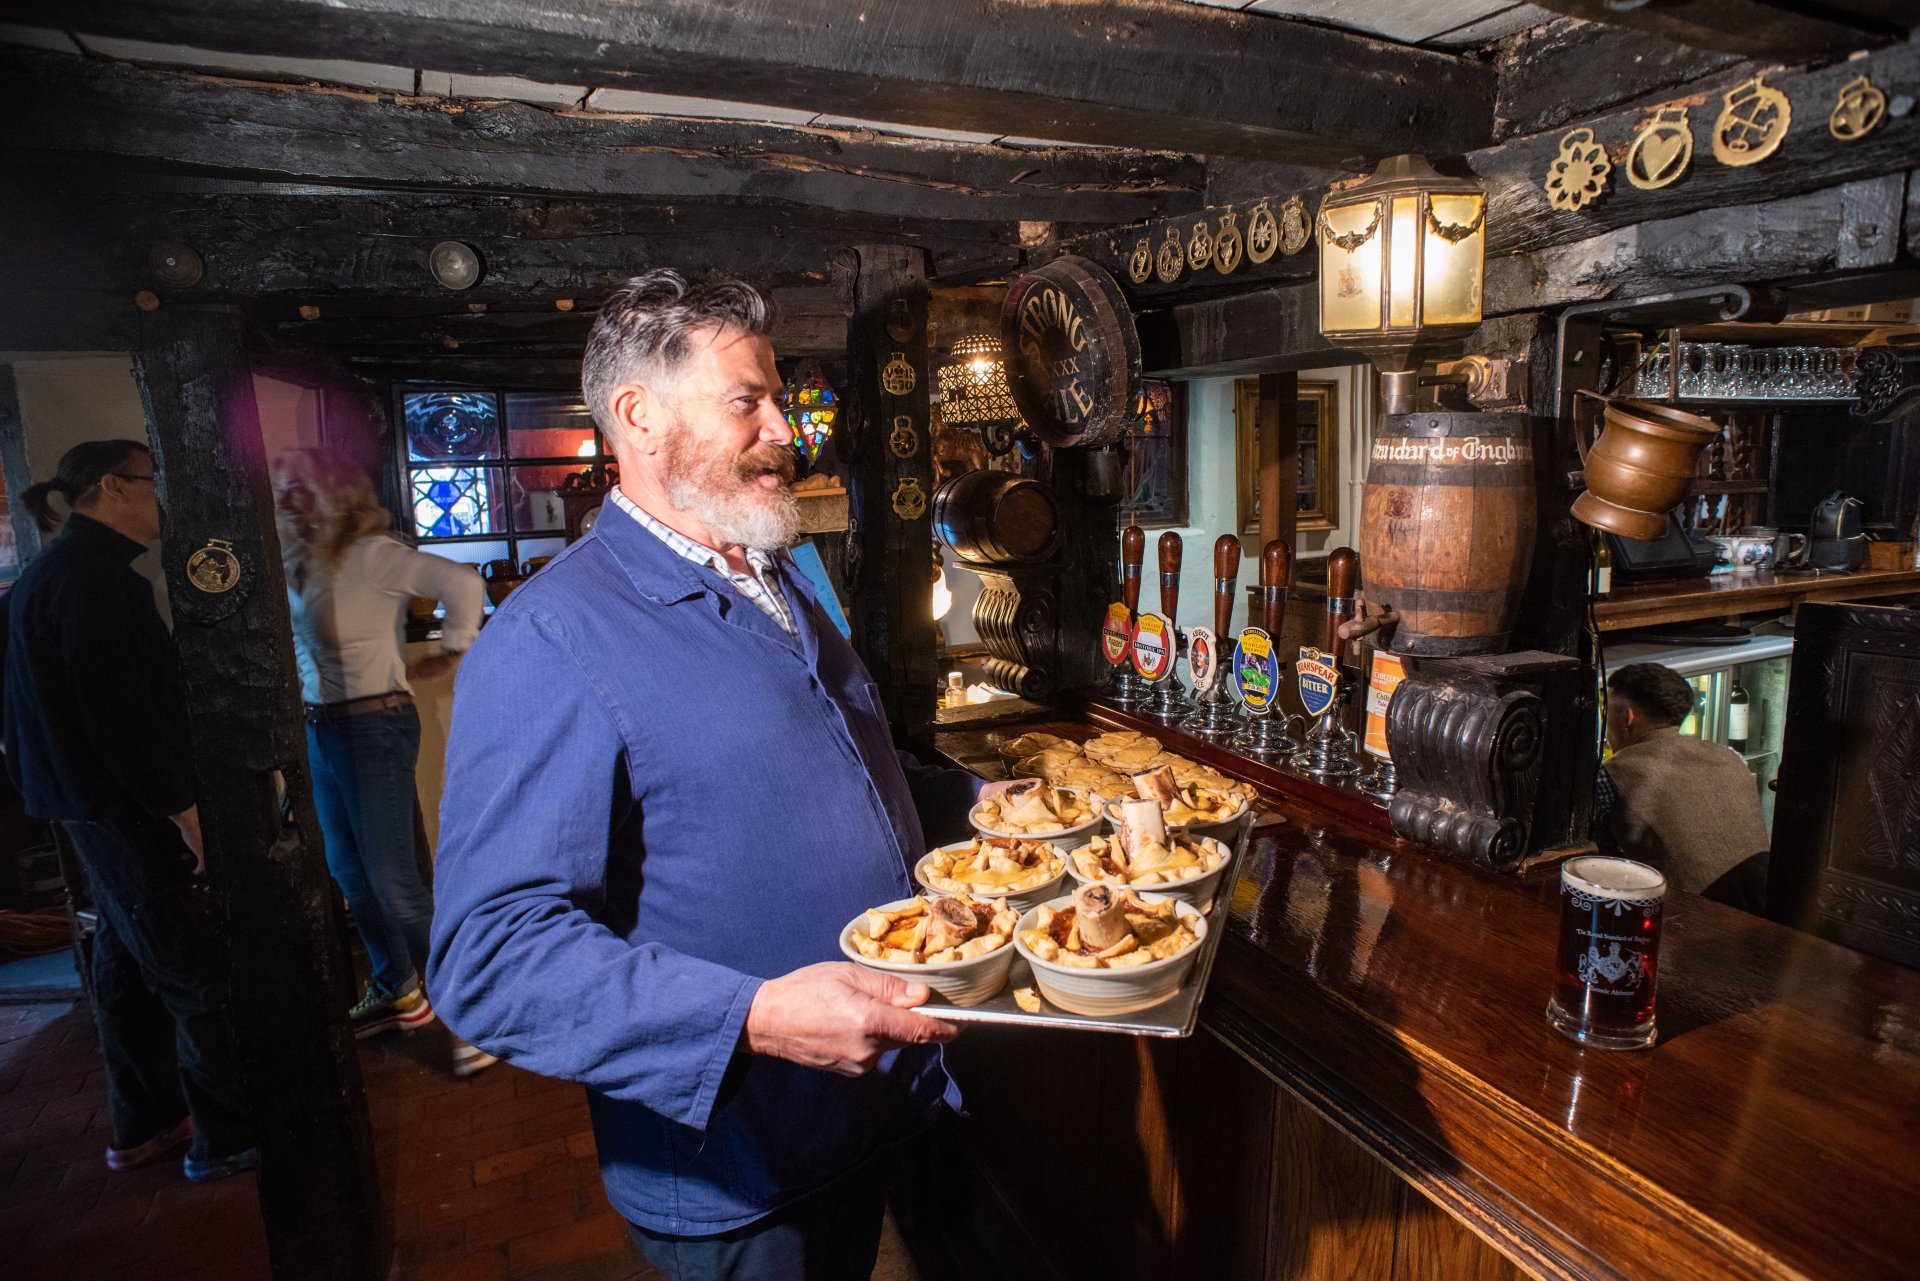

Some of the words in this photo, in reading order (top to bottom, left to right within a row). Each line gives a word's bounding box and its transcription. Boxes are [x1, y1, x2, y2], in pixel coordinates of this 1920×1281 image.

[1019, 288, 1088, 362] STRONG
[1445, 447, 1460, 461] of
[1298, 661, 1335, 682] BRAKSPEAR
[1302, 677, 1329, 694] BITTER
